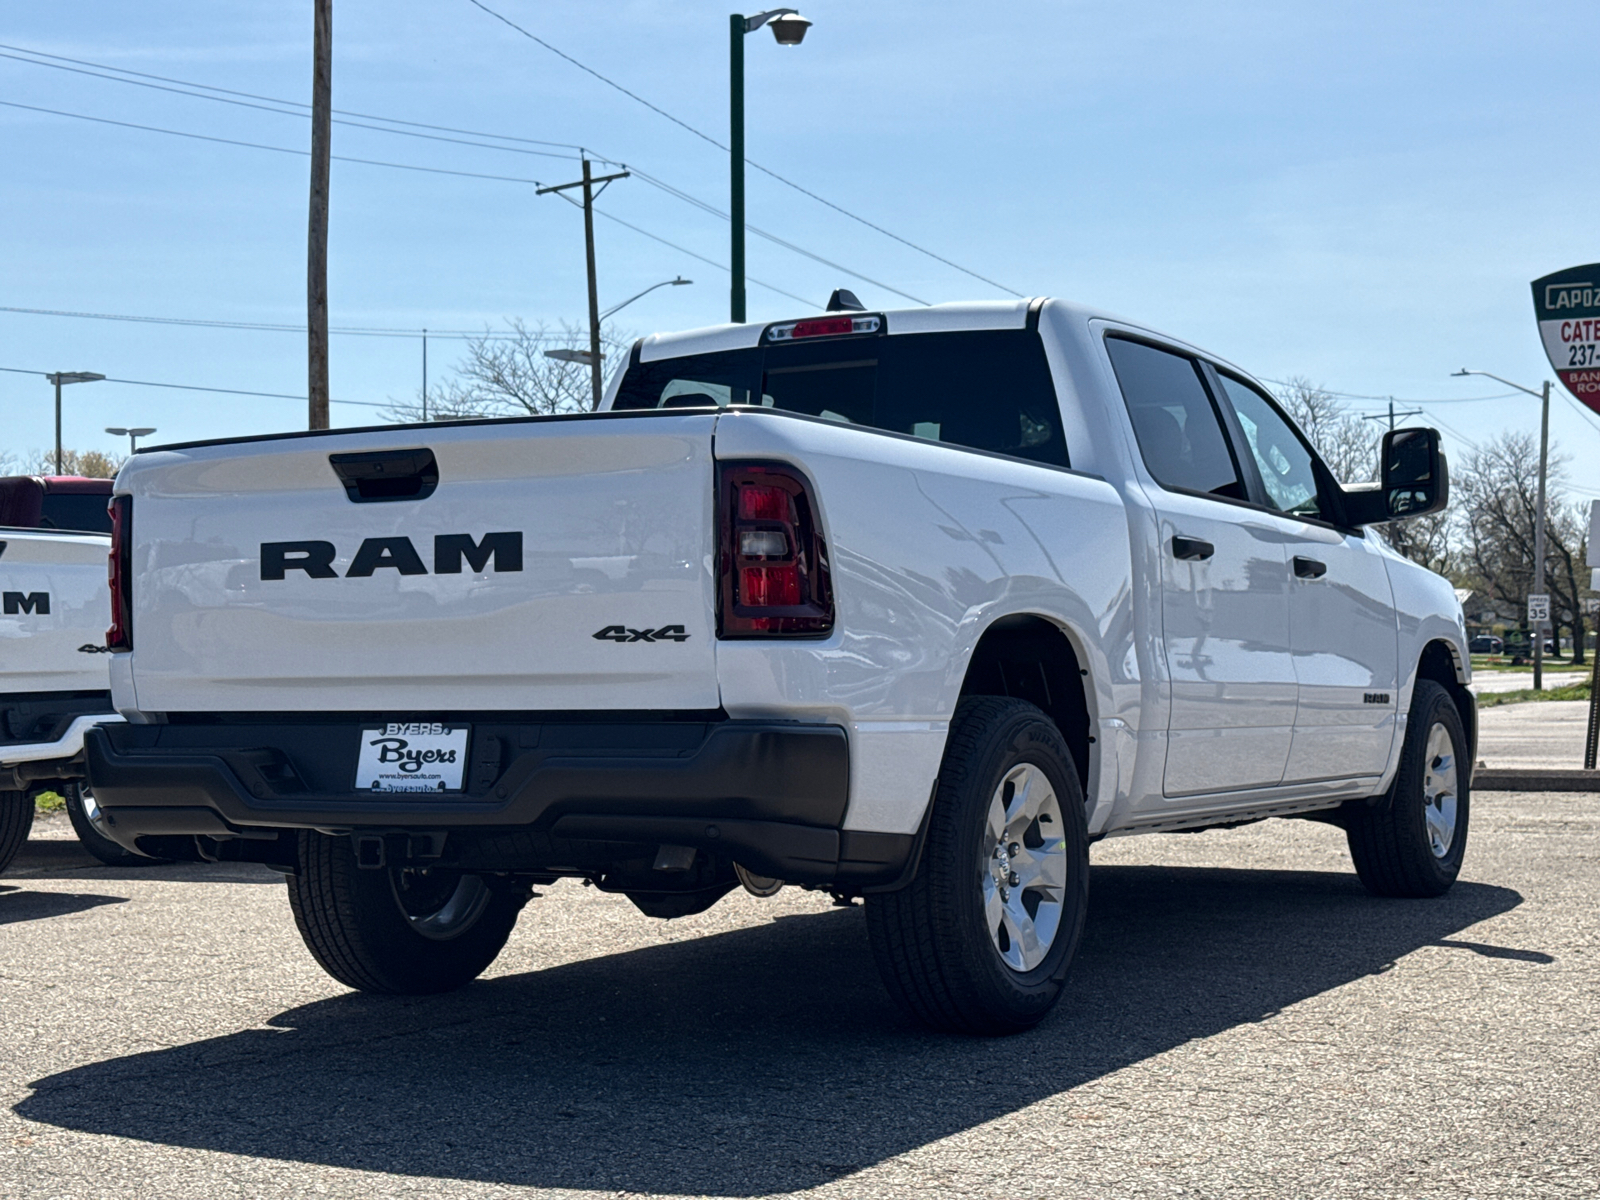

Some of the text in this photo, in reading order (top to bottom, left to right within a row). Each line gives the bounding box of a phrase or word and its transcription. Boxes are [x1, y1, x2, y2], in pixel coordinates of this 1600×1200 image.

[1561, 320, 1600, 343] CATE
[1577, 381, 1600, 393] RO
[260, 531, 523, 580] RAM
[0, 591, 50, 615] M
[1530, 608, 1547, 619] 35
[592, 625, 691, 642] 4x4
[386, 723, 443, 735] BYERS
[369, 738, 456, 773] Byers
[378, 772, 441, 782] www.byersauto.com
